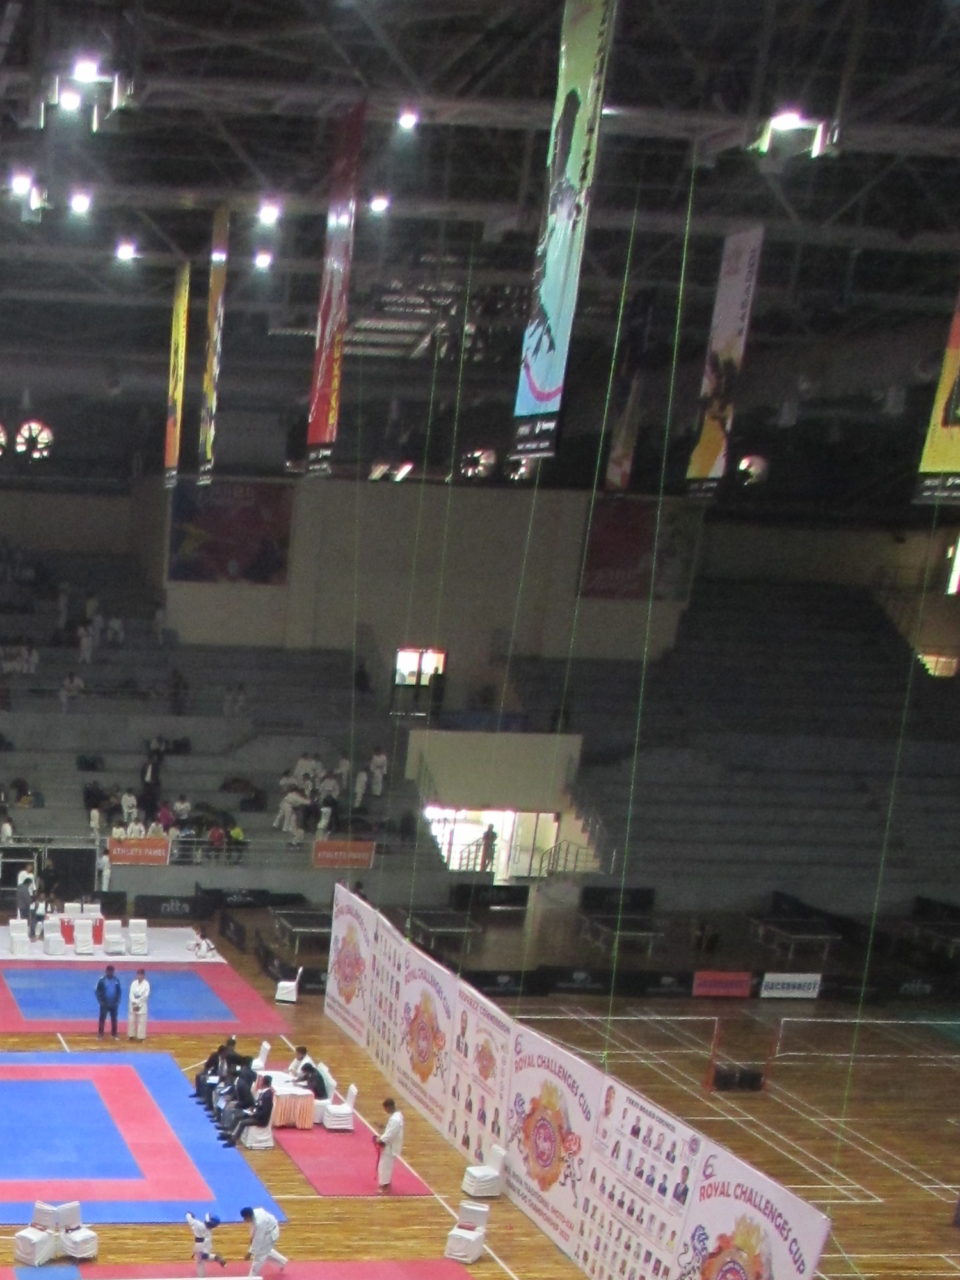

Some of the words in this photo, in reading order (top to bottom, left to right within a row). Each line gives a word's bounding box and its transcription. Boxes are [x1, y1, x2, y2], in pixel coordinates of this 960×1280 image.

[514, 1055, 535, 1073] ROYAL
[579, 1093, 591, 1122] CUP
[702, 1154, 718, 1180] 6
[699, 1181, 731, 1202] ROYAL
[734, 1183, 792, 1241] CHALLENGES
[788, 1238, 806, 1274] CUP
